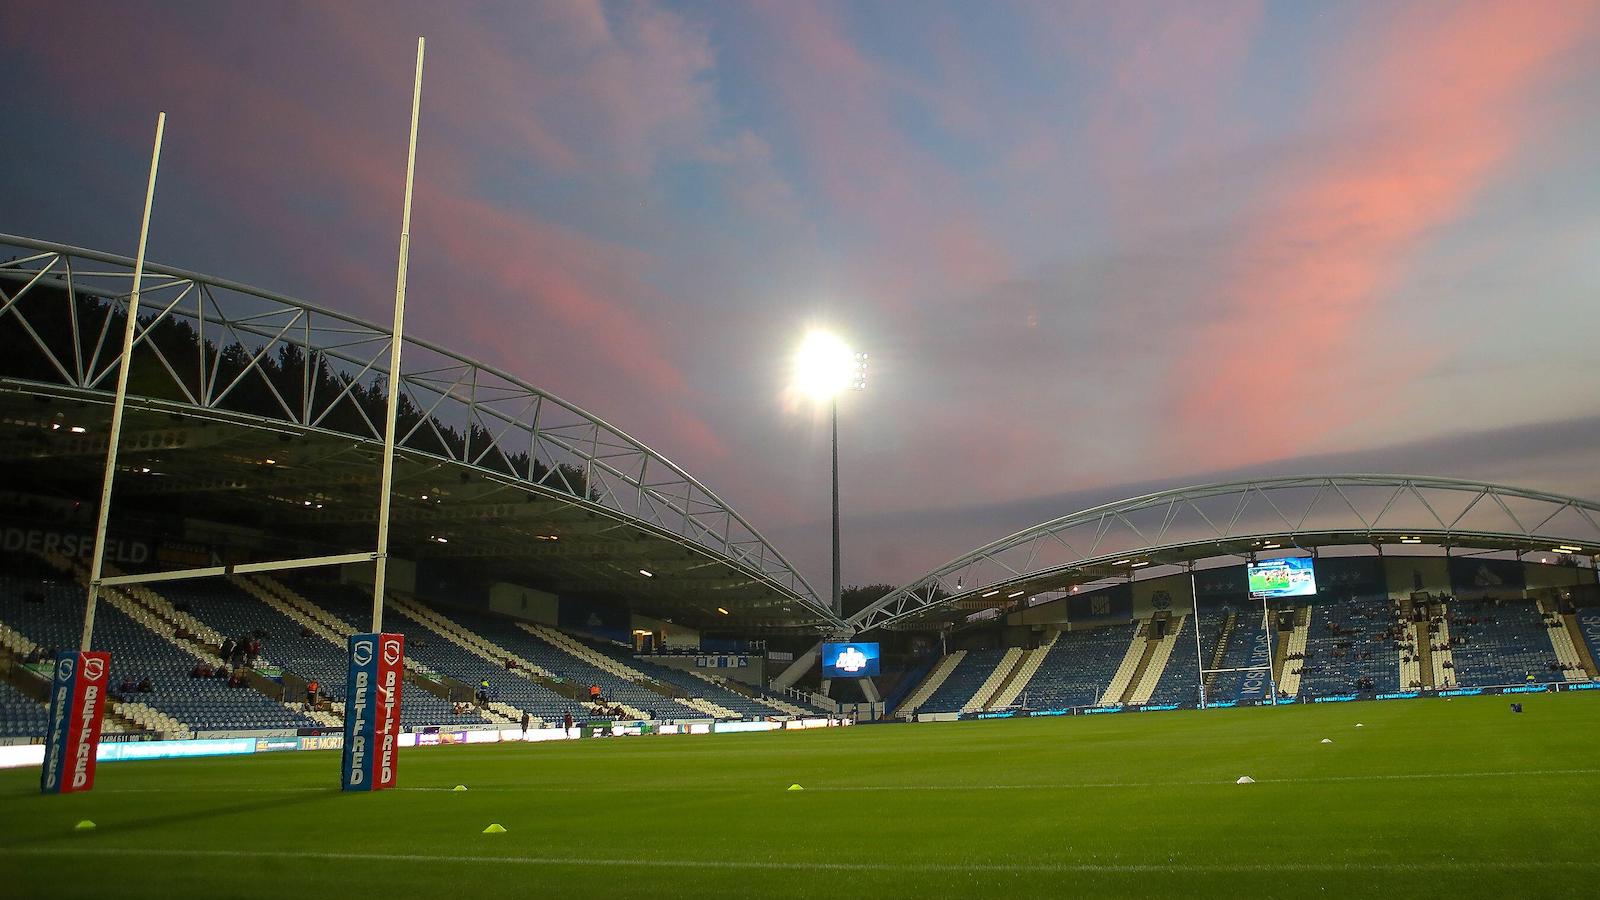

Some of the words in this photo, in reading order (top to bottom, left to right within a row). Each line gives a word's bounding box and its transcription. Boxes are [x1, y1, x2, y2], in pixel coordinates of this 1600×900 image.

[47, 686, 68, 788] BETFRED
[72, 685, 98, 787] BETFRED
[302, 738, 318, 750] THE
[351, 671, 368, 785] BETFRED
[381, 671, 396, 784] BETFRED
